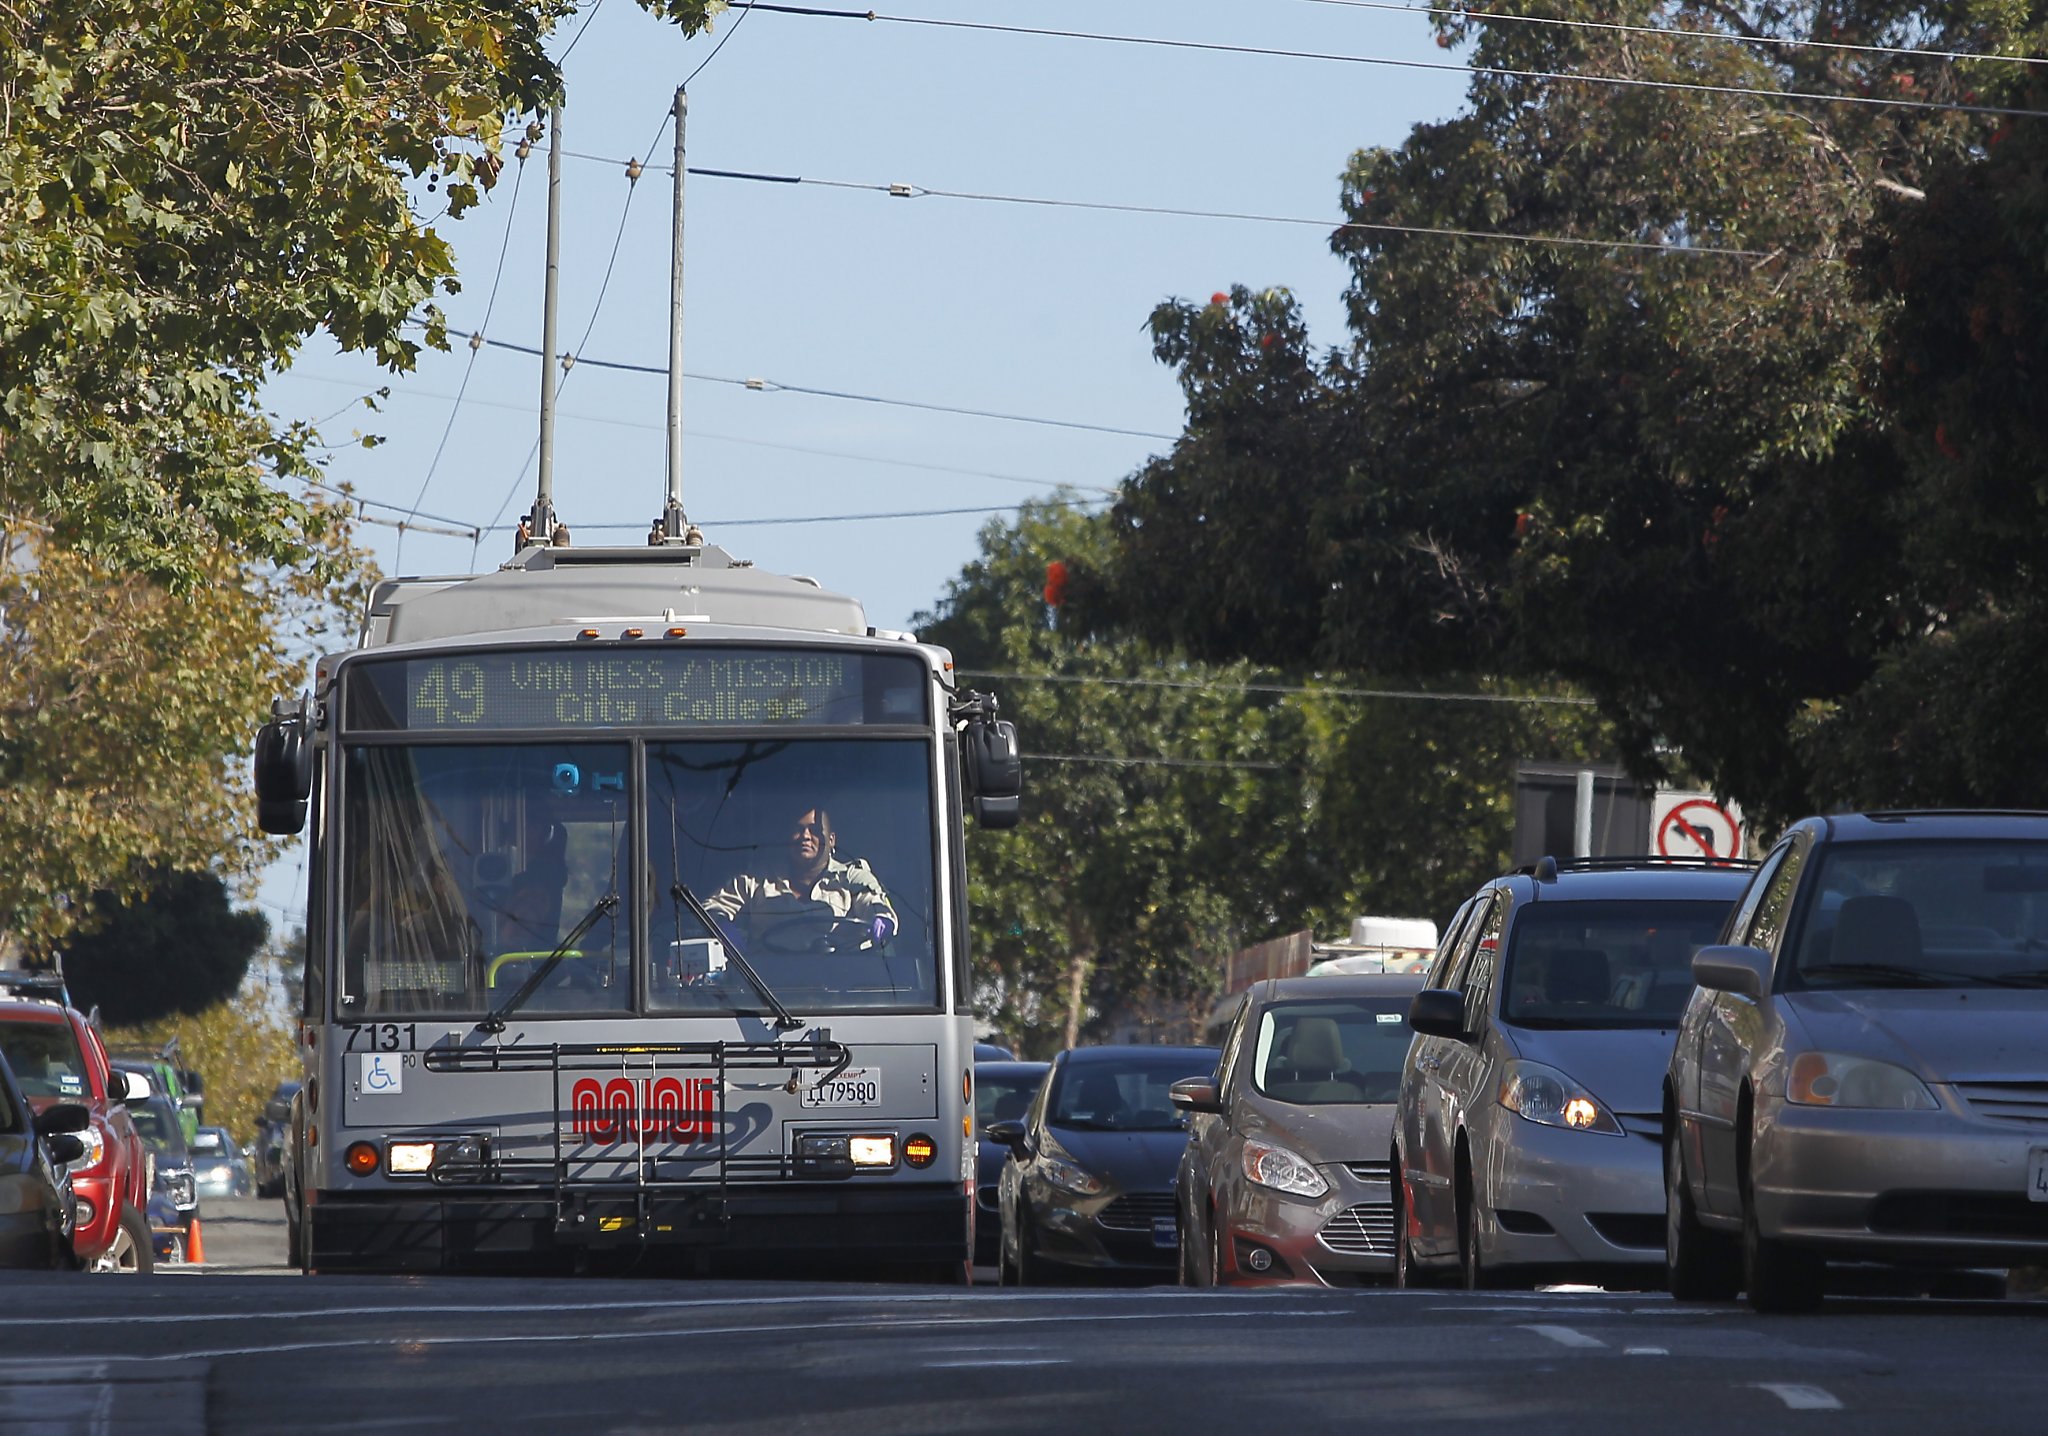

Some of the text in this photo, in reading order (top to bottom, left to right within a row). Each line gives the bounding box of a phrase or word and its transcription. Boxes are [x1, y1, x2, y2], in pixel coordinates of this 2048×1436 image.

[511, 661, 573, 690] VAN
[587, 660, 664, 689] NESS
[710, 658, 842, 688] MISSION
[415, 663, 484, 723] 49
[556, 691, 808, 722] City College
[342, 1024, 416, 1051] 7131
[807, 1082, 876, 1102] 1179580
